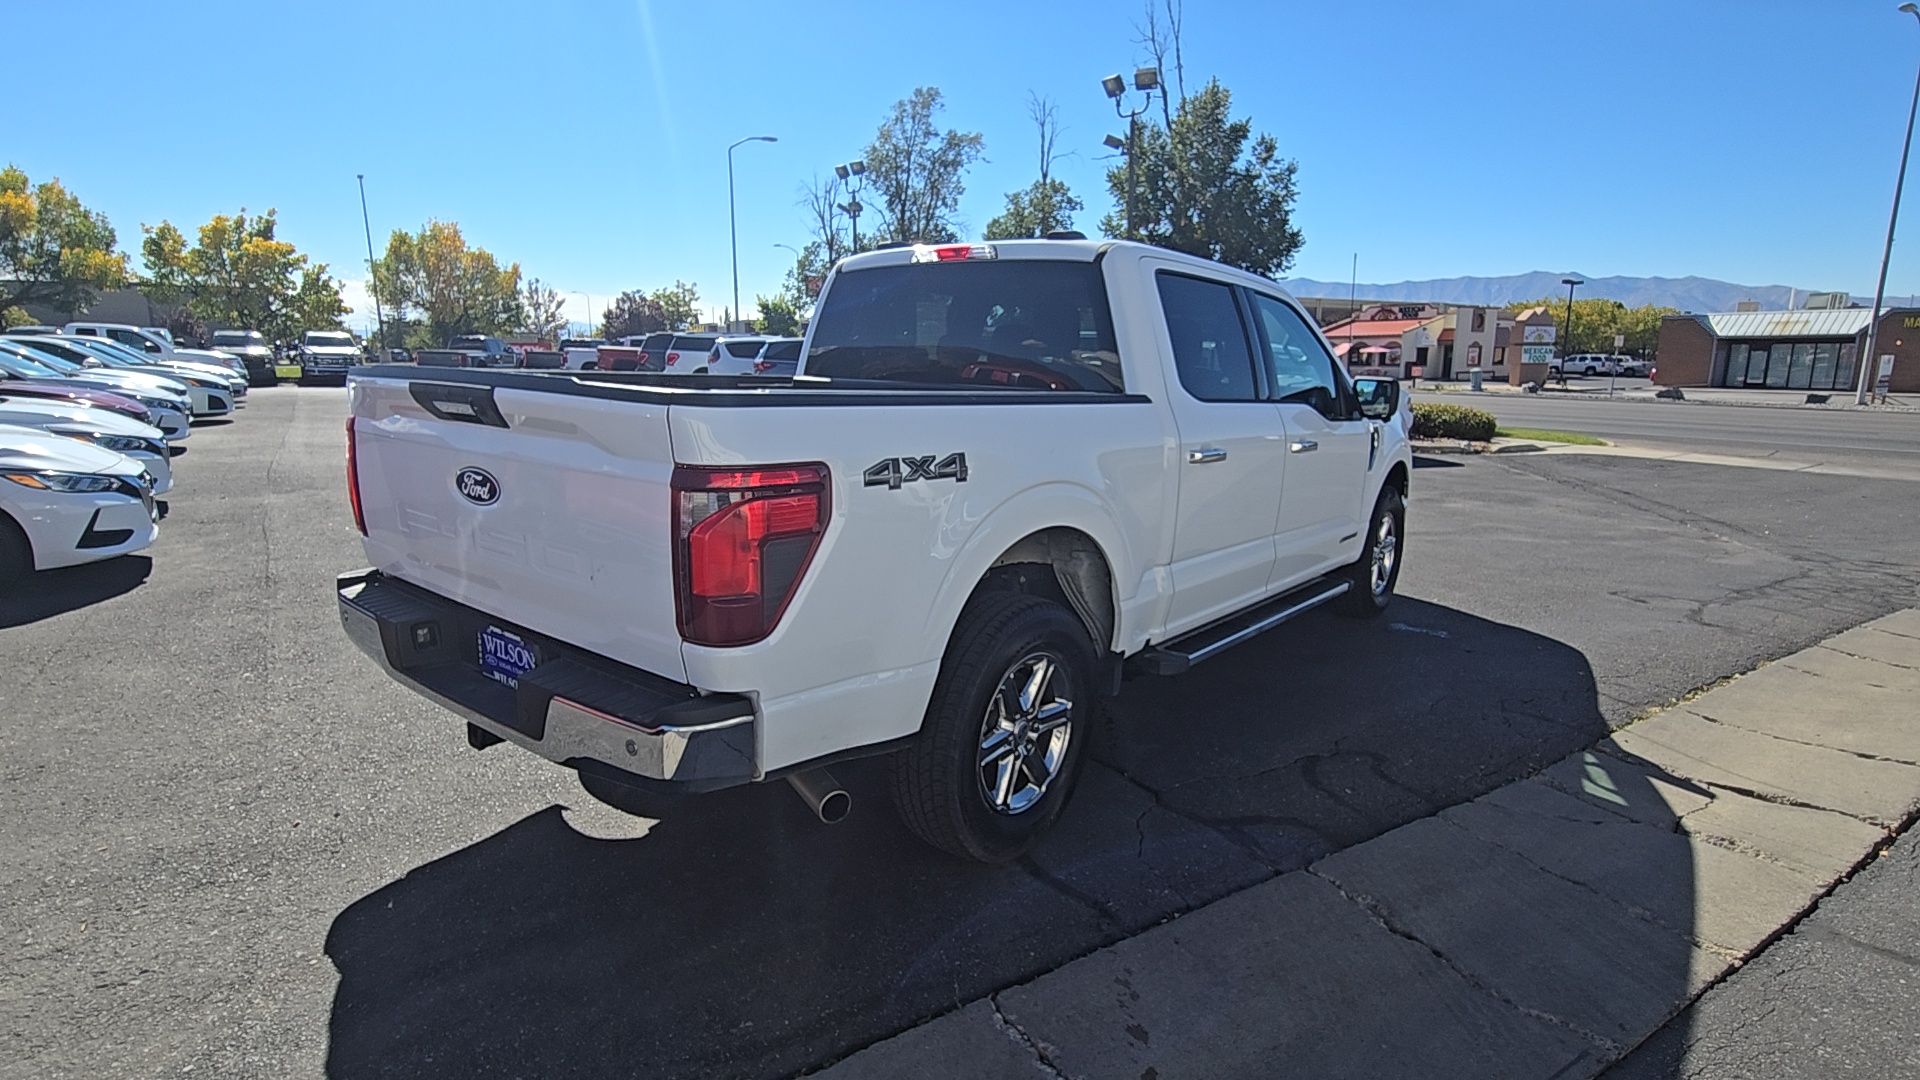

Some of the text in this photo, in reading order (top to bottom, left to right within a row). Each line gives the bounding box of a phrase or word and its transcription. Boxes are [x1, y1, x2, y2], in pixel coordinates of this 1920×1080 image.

[1523, 347, 1553, 355] MEXICAN
[1528, 354, 1547, 363] FOOD
[461, 471, 491, 500] Ford
[482, 633, 536, 670] WILSON
